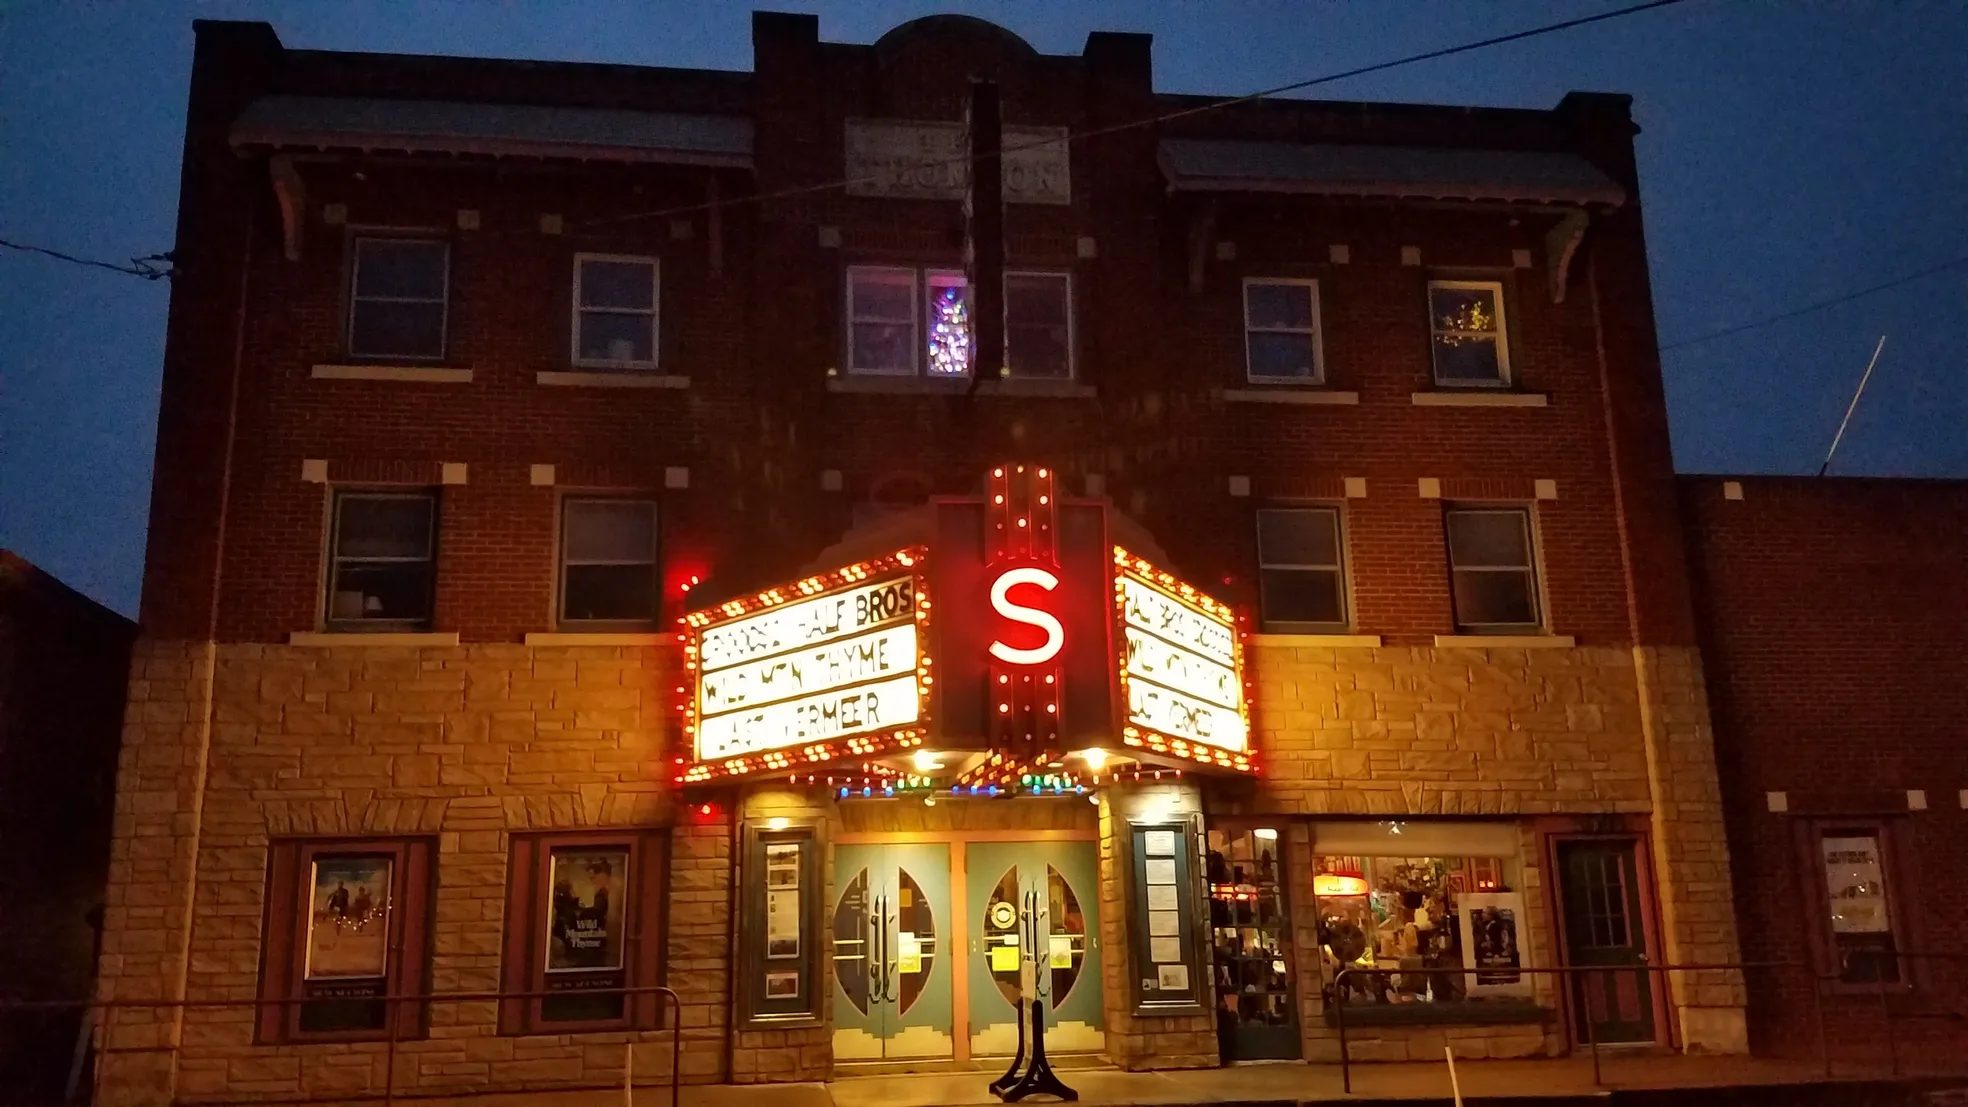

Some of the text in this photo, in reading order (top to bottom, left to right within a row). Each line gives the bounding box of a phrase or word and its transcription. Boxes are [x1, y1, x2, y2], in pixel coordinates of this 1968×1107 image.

[798, 581, 912, 639] ALF BROS
[988, 567, 1065, 665] S
[815, 637, 889, 685] THYME
[718, 691, 880, 751] AST ERMEER
[576, 918, 598, 929] Wild
